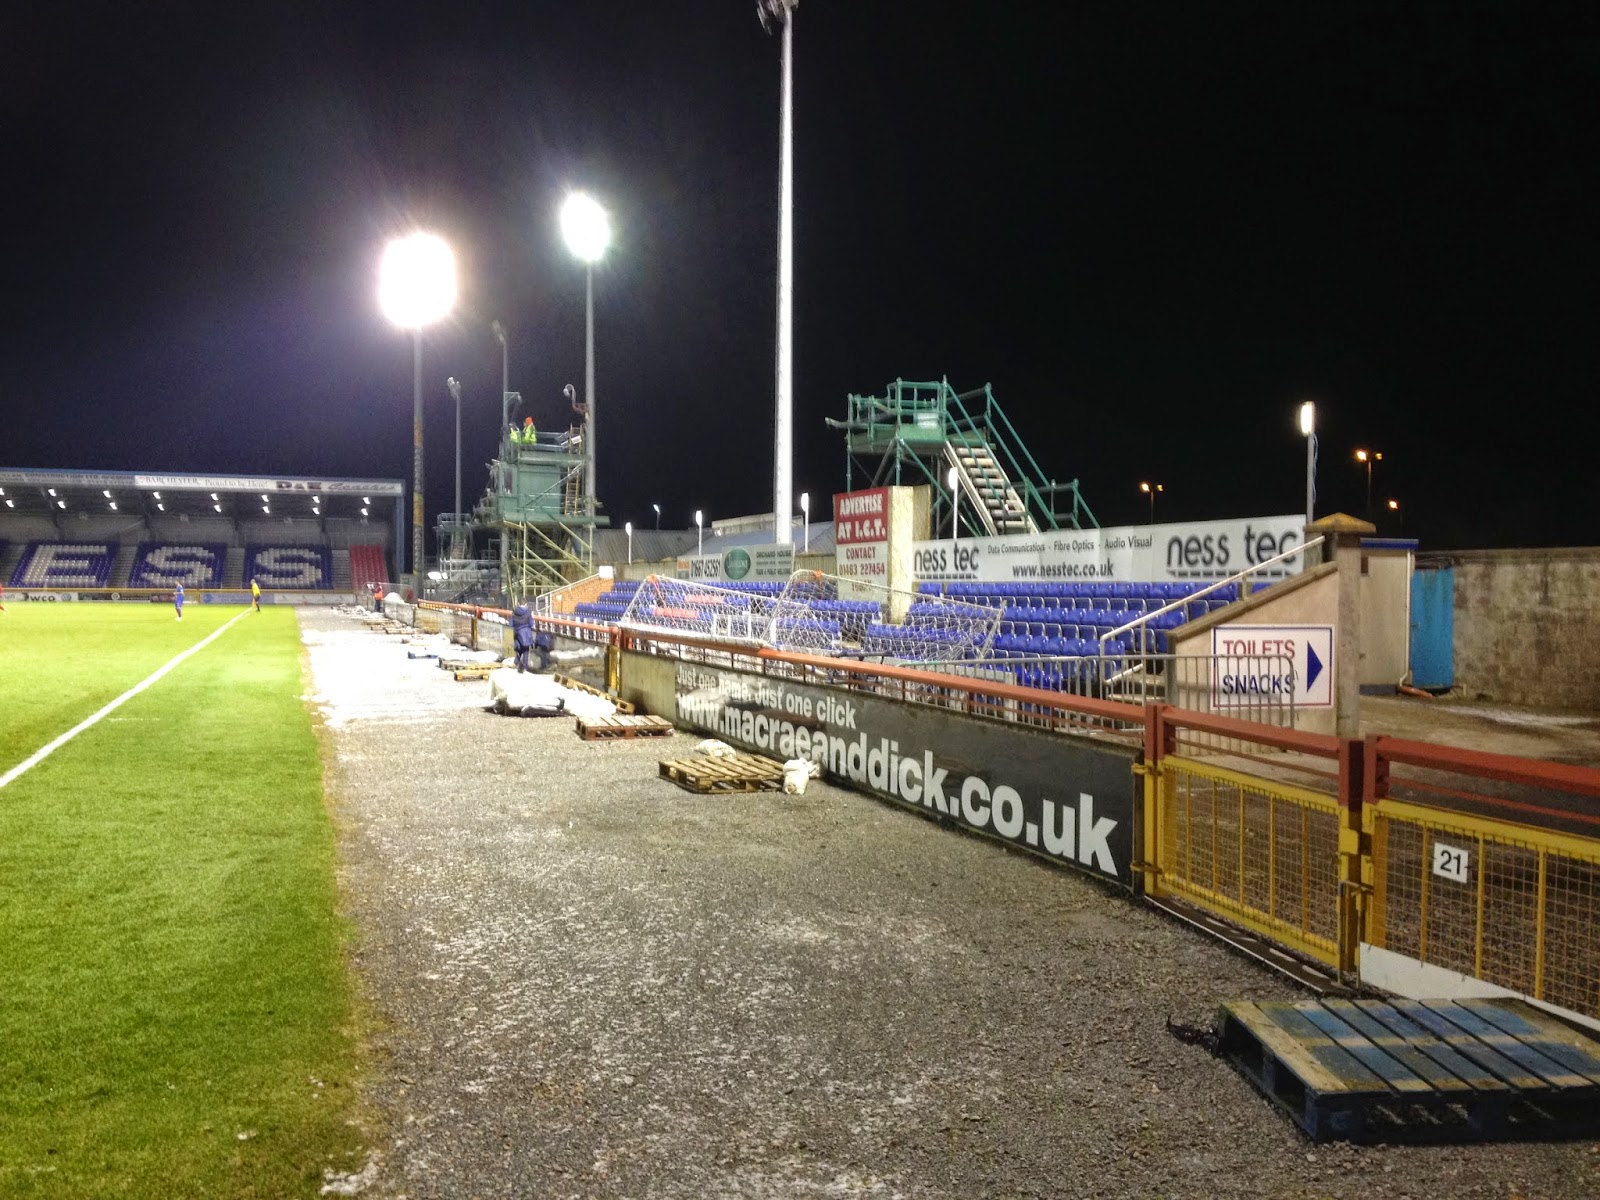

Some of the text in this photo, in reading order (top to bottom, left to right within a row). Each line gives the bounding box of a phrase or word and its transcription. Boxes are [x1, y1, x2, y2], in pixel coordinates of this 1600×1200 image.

[840, 494, 883, 516] ADVERTISE
[838, 518, 886, 540] AT I.C.T.
[988, 542, 1046, 554] Data Communications
[1053, 539, 1095, 554] Fibre Optics
[1104, 535, 1153, 549] Audio Visual
[1167, 523, 1298, 568] ness tec
[846, 546, 876, 560] CONTACT
[913, 542, 980, 573] ness tec
[860, 562, 885, 575] 227454
[1012, 558, 1115, 578] www.nesstec.co.uk
[1223, 639, 1295, 659] TOILETS
[1222, 674, 1295, 695] SNACKS
[677, 665, 696, 687] Just
[698, 673, 716, 692] one
[755, 681, 783, 710] Just
[786, 693, 812, 717] one
[816, 696, 856, 729] click
[677, 692, 1118, 876] www.macraeanddick.co.uk
[1439, 850, 1462, 875] 21
